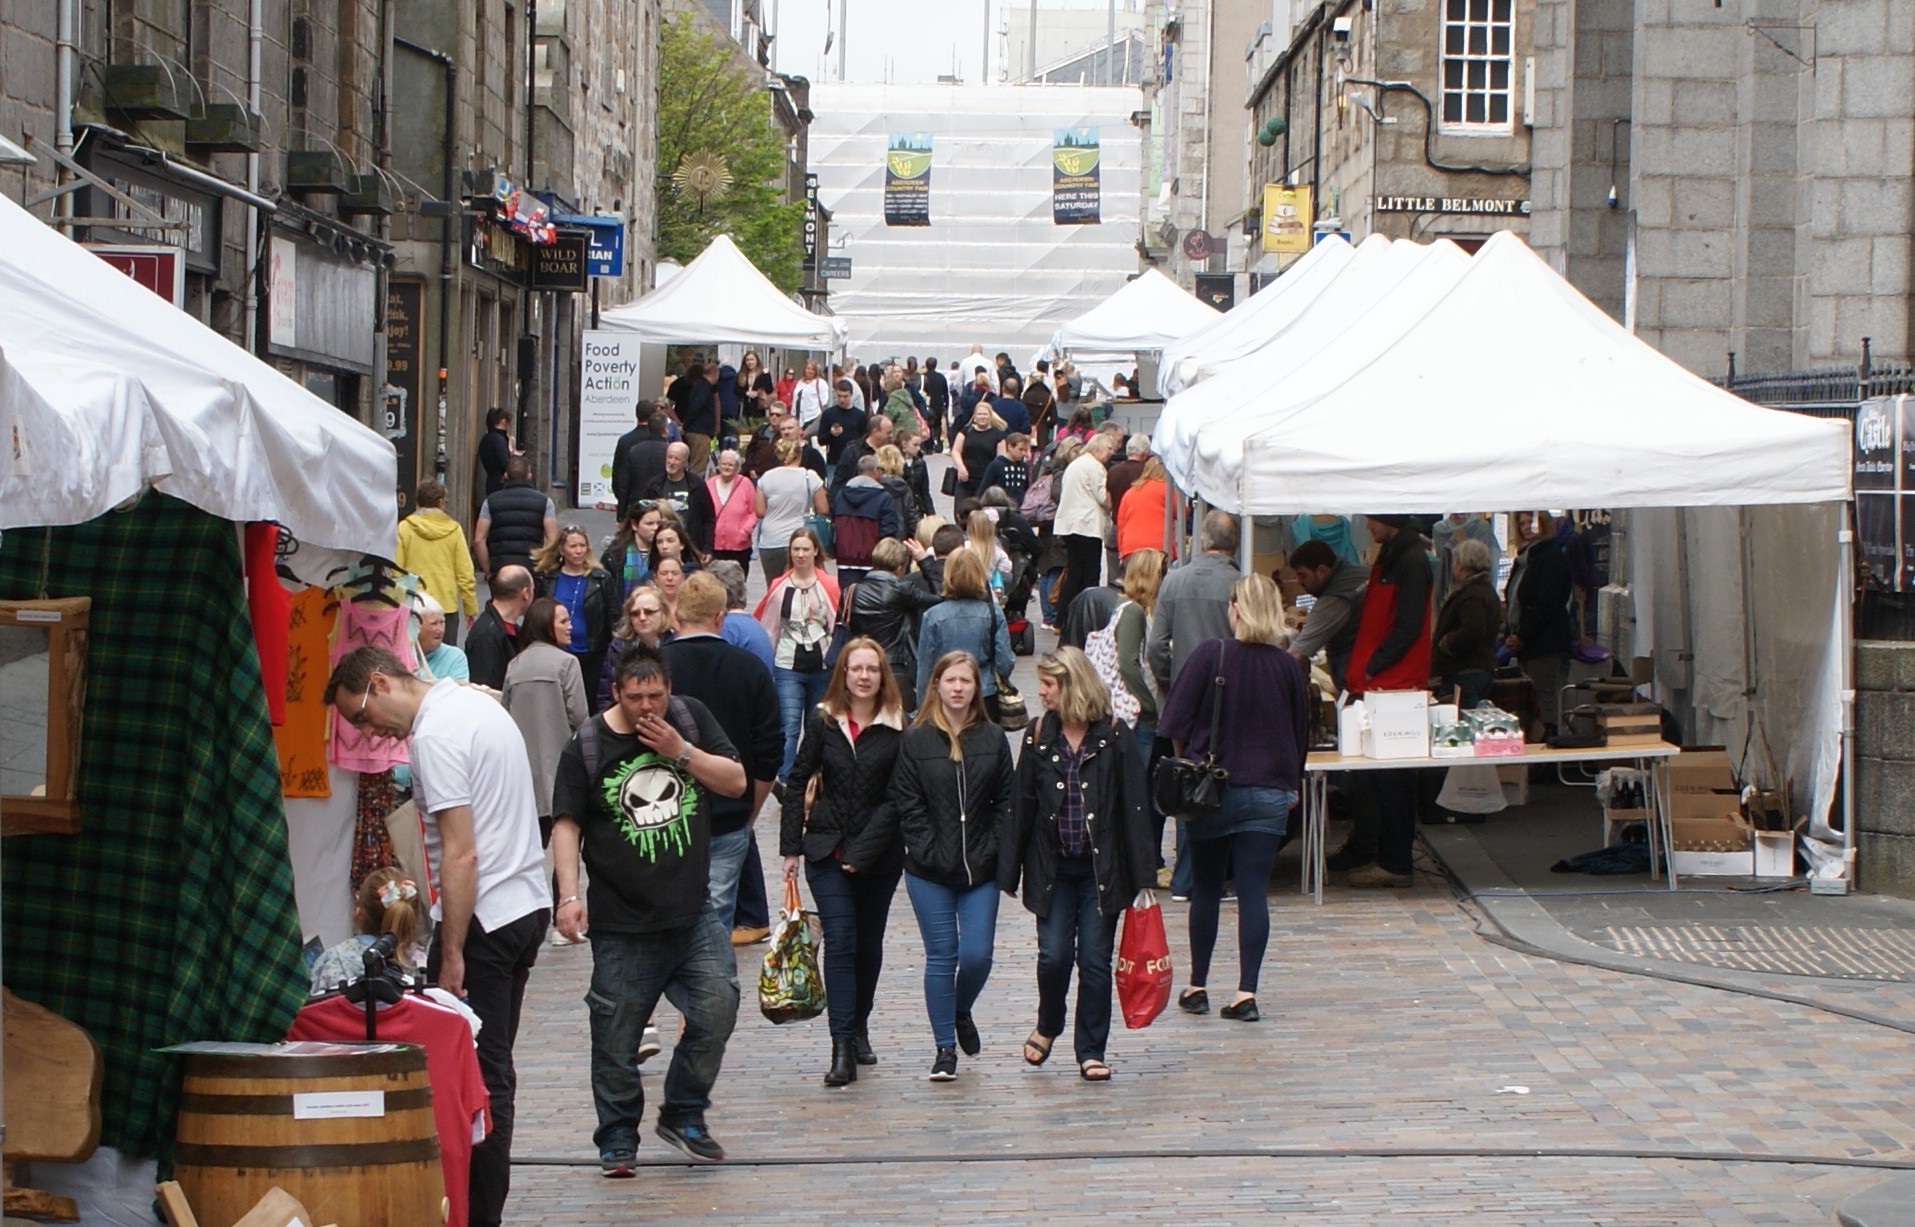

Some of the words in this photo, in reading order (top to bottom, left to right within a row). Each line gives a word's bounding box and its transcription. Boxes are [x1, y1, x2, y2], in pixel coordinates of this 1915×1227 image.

[1079, 192, 1099, 200] THIS
[1055, 201, 1099, 210] SATURDAY
[1377, 197, 1435, 211] LITTLE
[1441, 199, 1515, 213] BELMONT
[805, 178, 816, 254] BELMONT
[541, 249, 577, 261] WILD
[540, 262, 578, 274] BOAR
[585, 342, 620, 357] Food
[585, 359, 637, 377] Poverty
[585, 376, 630, 391] Action
[585, 394, 631, 404] Aberdeen
